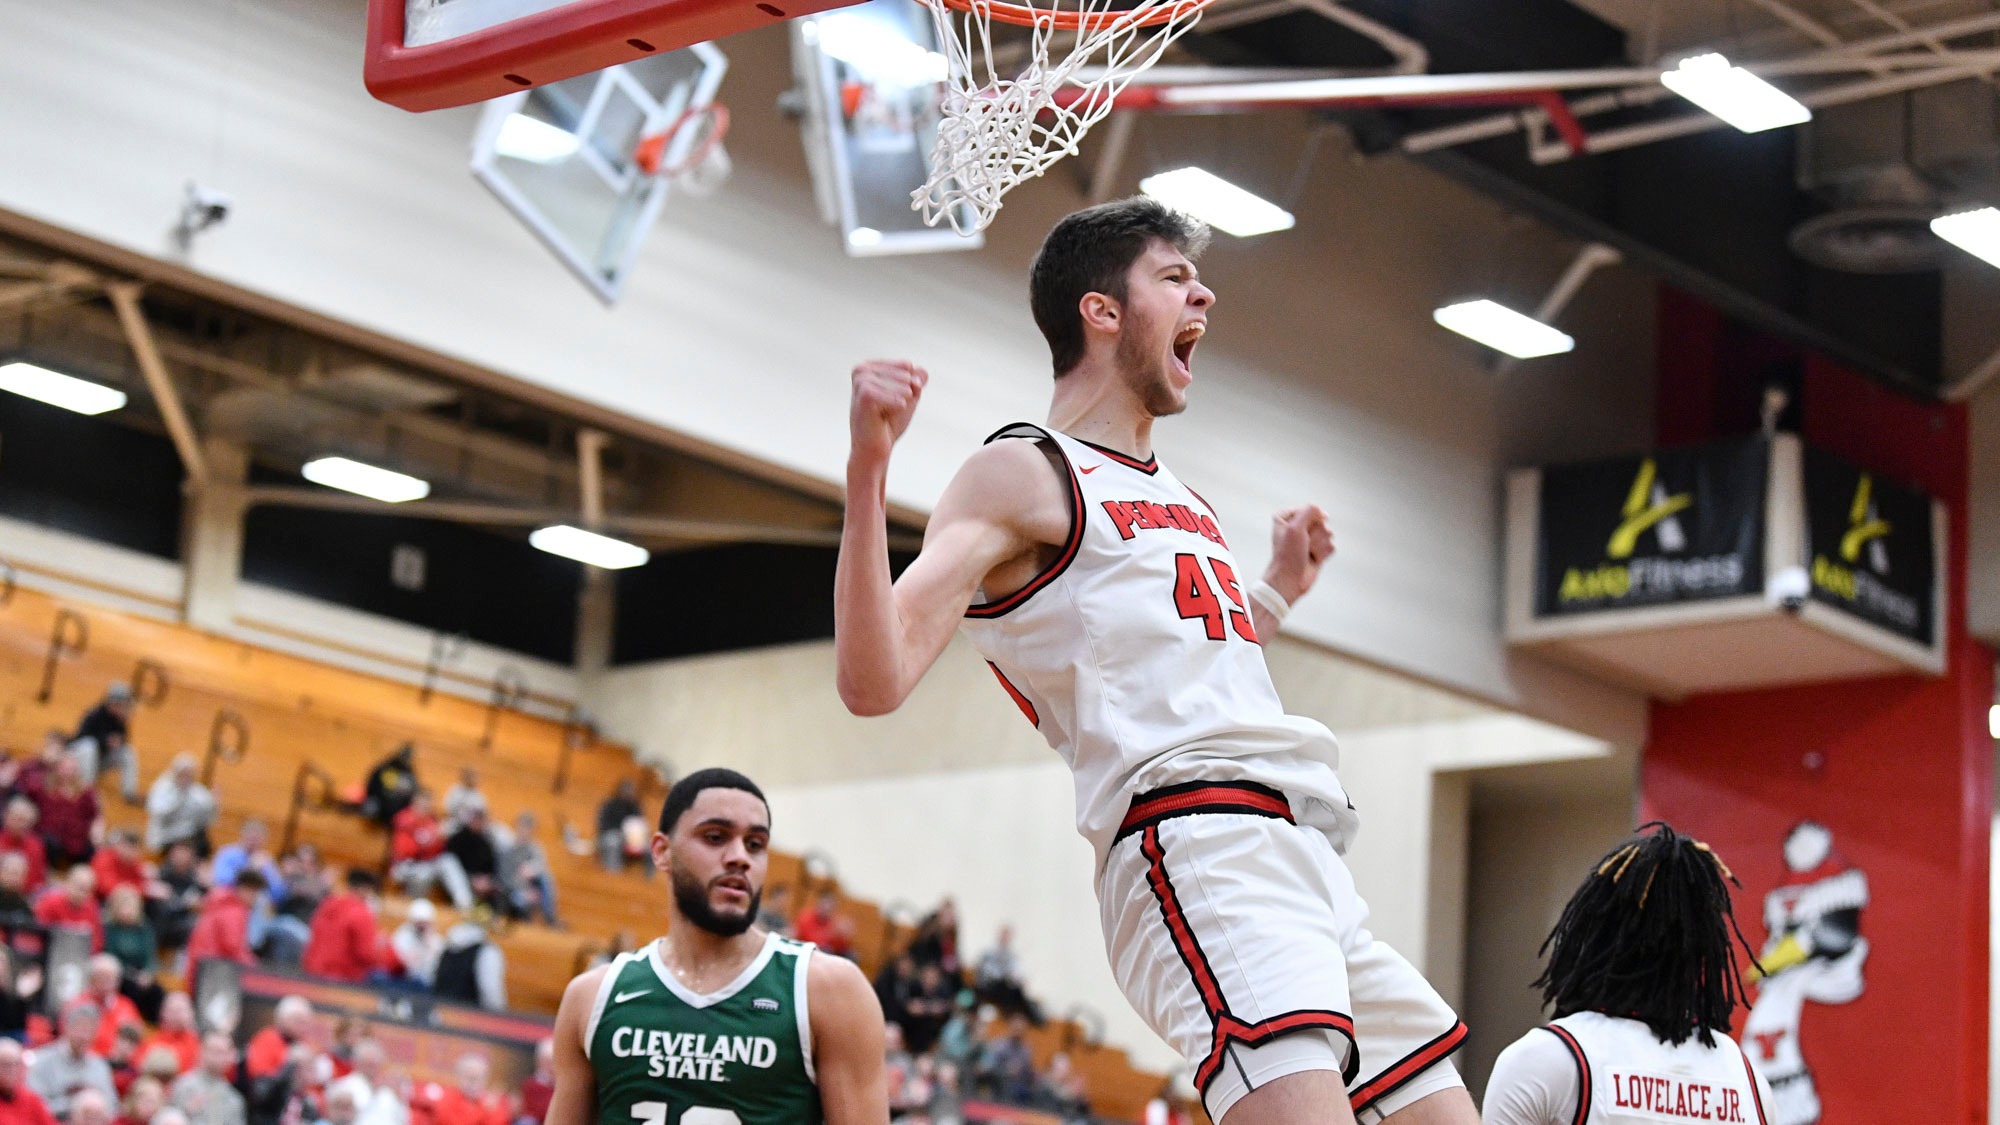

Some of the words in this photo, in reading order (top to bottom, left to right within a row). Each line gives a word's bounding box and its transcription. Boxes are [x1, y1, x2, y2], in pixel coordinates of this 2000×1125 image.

[1173, 553, 1262, 647] 45
[611, 1026, 777, 1069] CLEVELAND
[647, 1054, 726, 1082] STATE
[1613, 1074, 1711, 1120] LOVELACE
[1716, 1087, 1746, 1124] JR.
